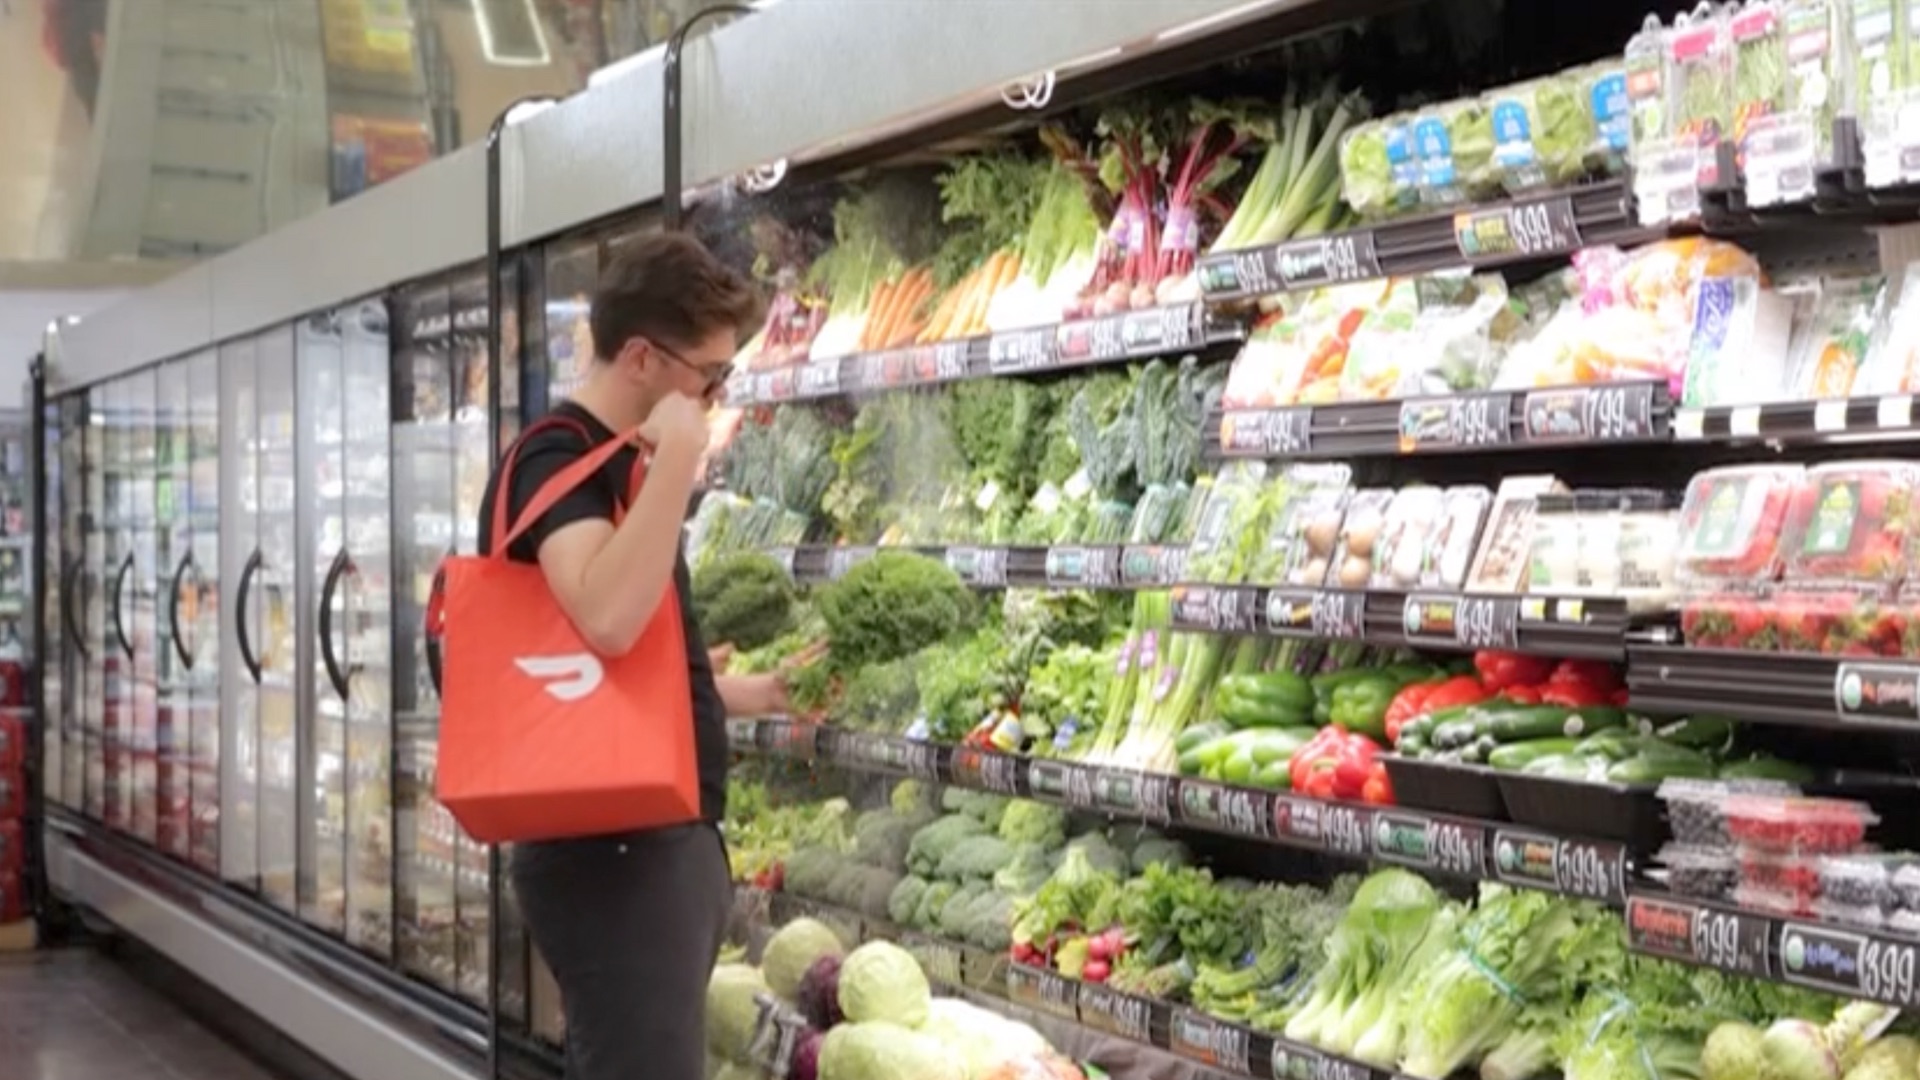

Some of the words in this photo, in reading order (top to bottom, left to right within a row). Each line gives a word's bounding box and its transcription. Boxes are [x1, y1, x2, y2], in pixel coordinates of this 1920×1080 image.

[1560, 840, 1596, 895] 599
[1697, 908, 1739, 968] 599
[1866, 941, 1915, 1005] 399
